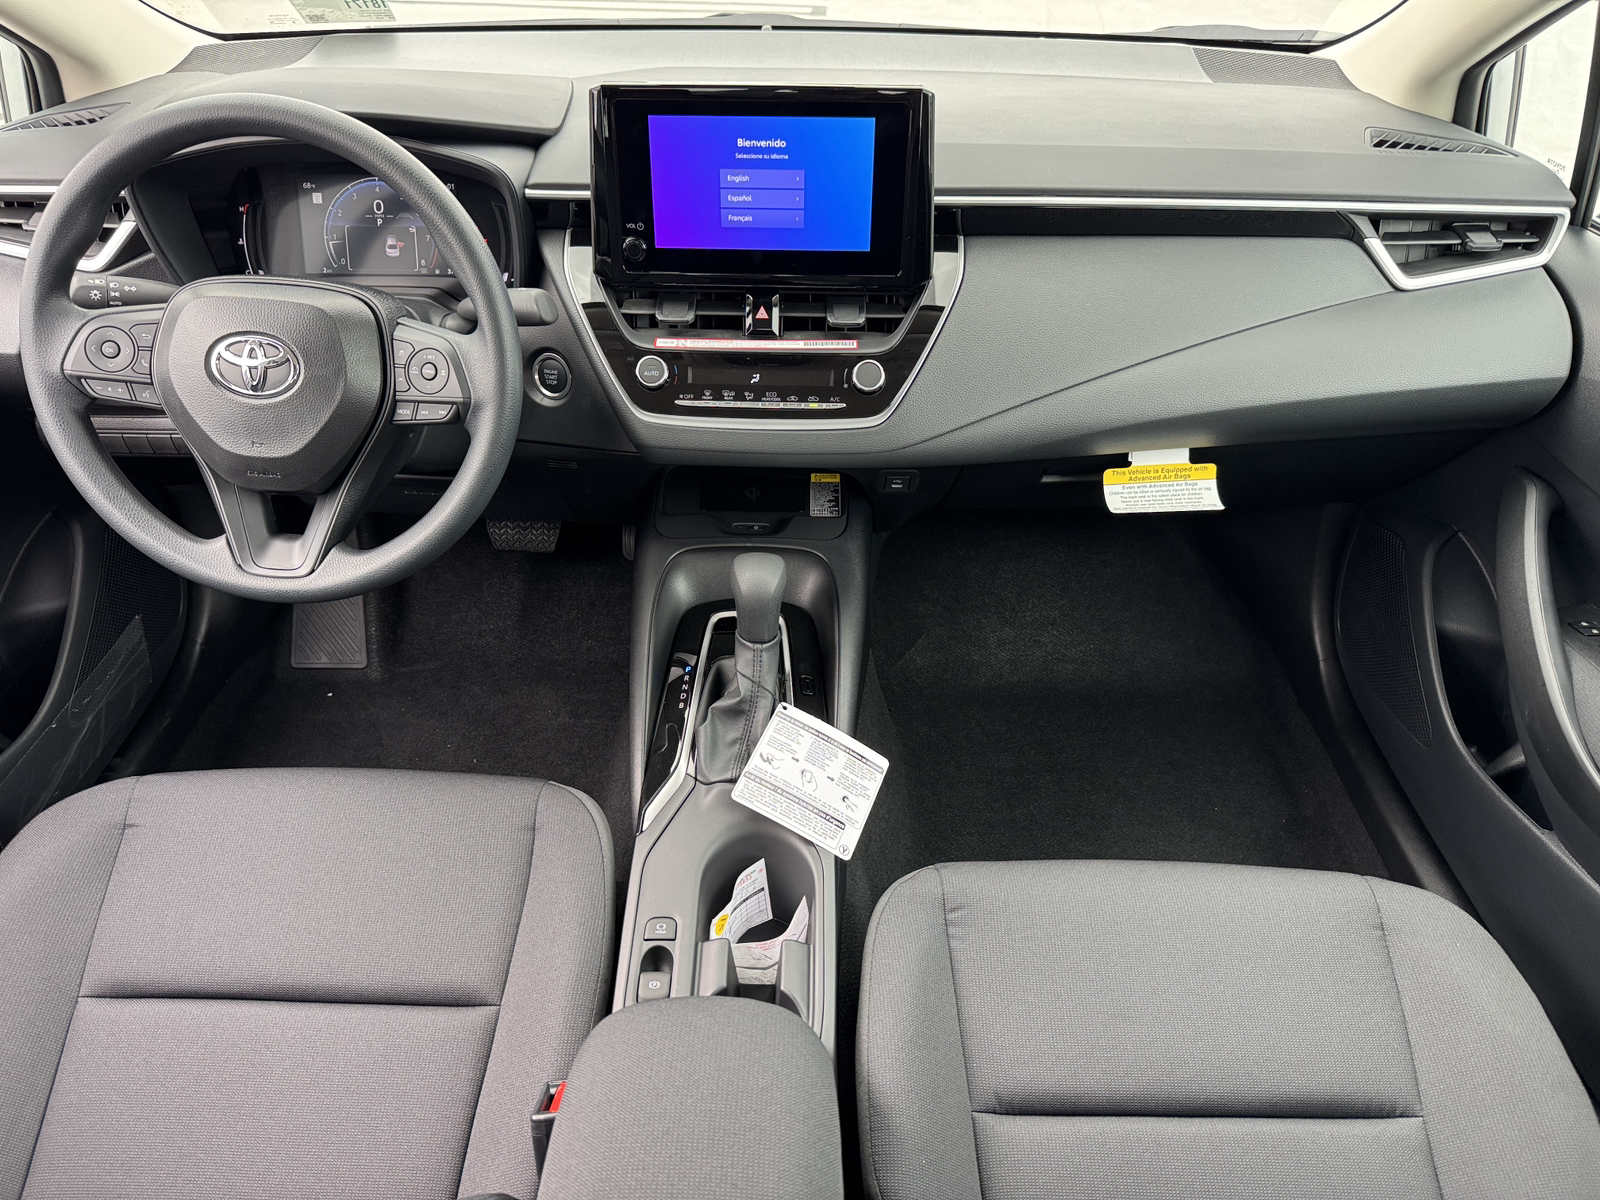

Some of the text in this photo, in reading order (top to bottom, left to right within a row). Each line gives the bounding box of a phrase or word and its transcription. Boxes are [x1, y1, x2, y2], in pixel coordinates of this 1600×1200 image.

[737, 138, 786, 148] Bienvenido
[727, 175, 750, 183] English
[727, 194, 752, 203] Español
[373, 200, 384, 214] 0
[728, 214, 753, 223] Français
[1161, 466, 1192, 475] Equipped
